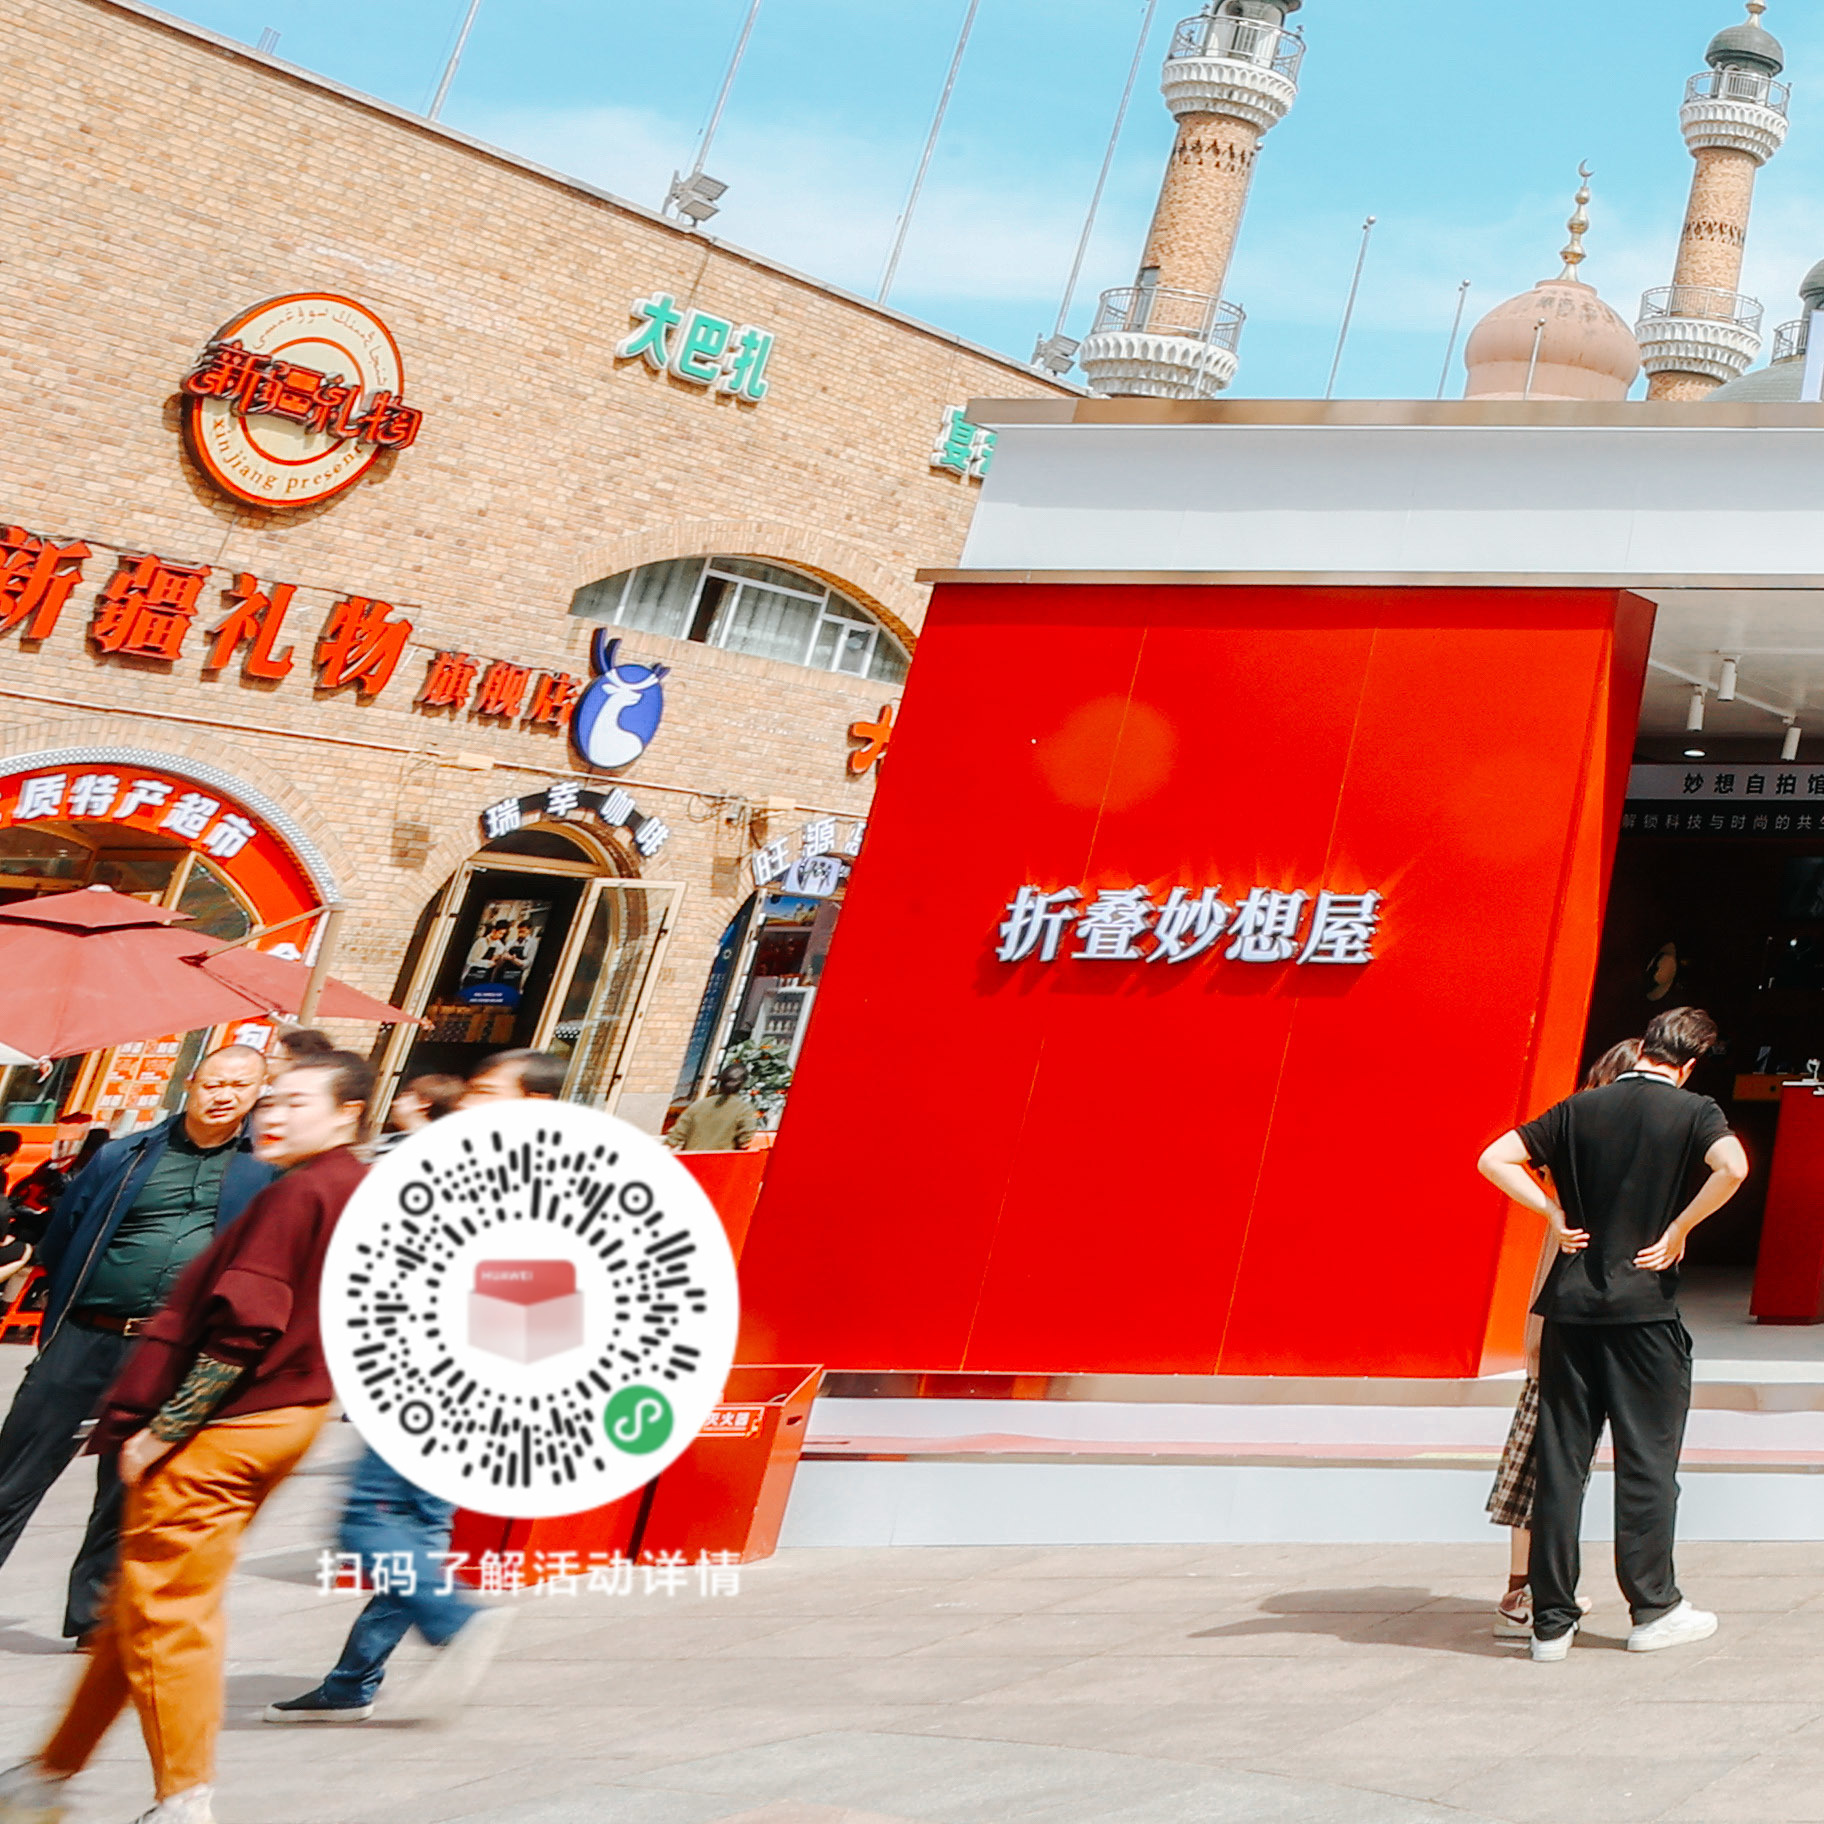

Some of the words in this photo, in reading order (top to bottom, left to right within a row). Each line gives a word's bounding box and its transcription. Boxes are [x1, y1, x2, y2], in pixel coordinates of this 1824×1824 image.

[618, 292, 777, 402] 大巴扎
[183, 339, 423, 451] 新疆礼物
[213, 417, 278, 491] xinjiang
[0, 525, 413, 697] 新疆礼物
[415, 650, 582, 730] 旗舰店
[0, 773, 257, 859] 质特产超市
[484, 781, 671, 858] 瑞幸咖啡
[996, 884, 1384, 966] 折叠妙想屋
